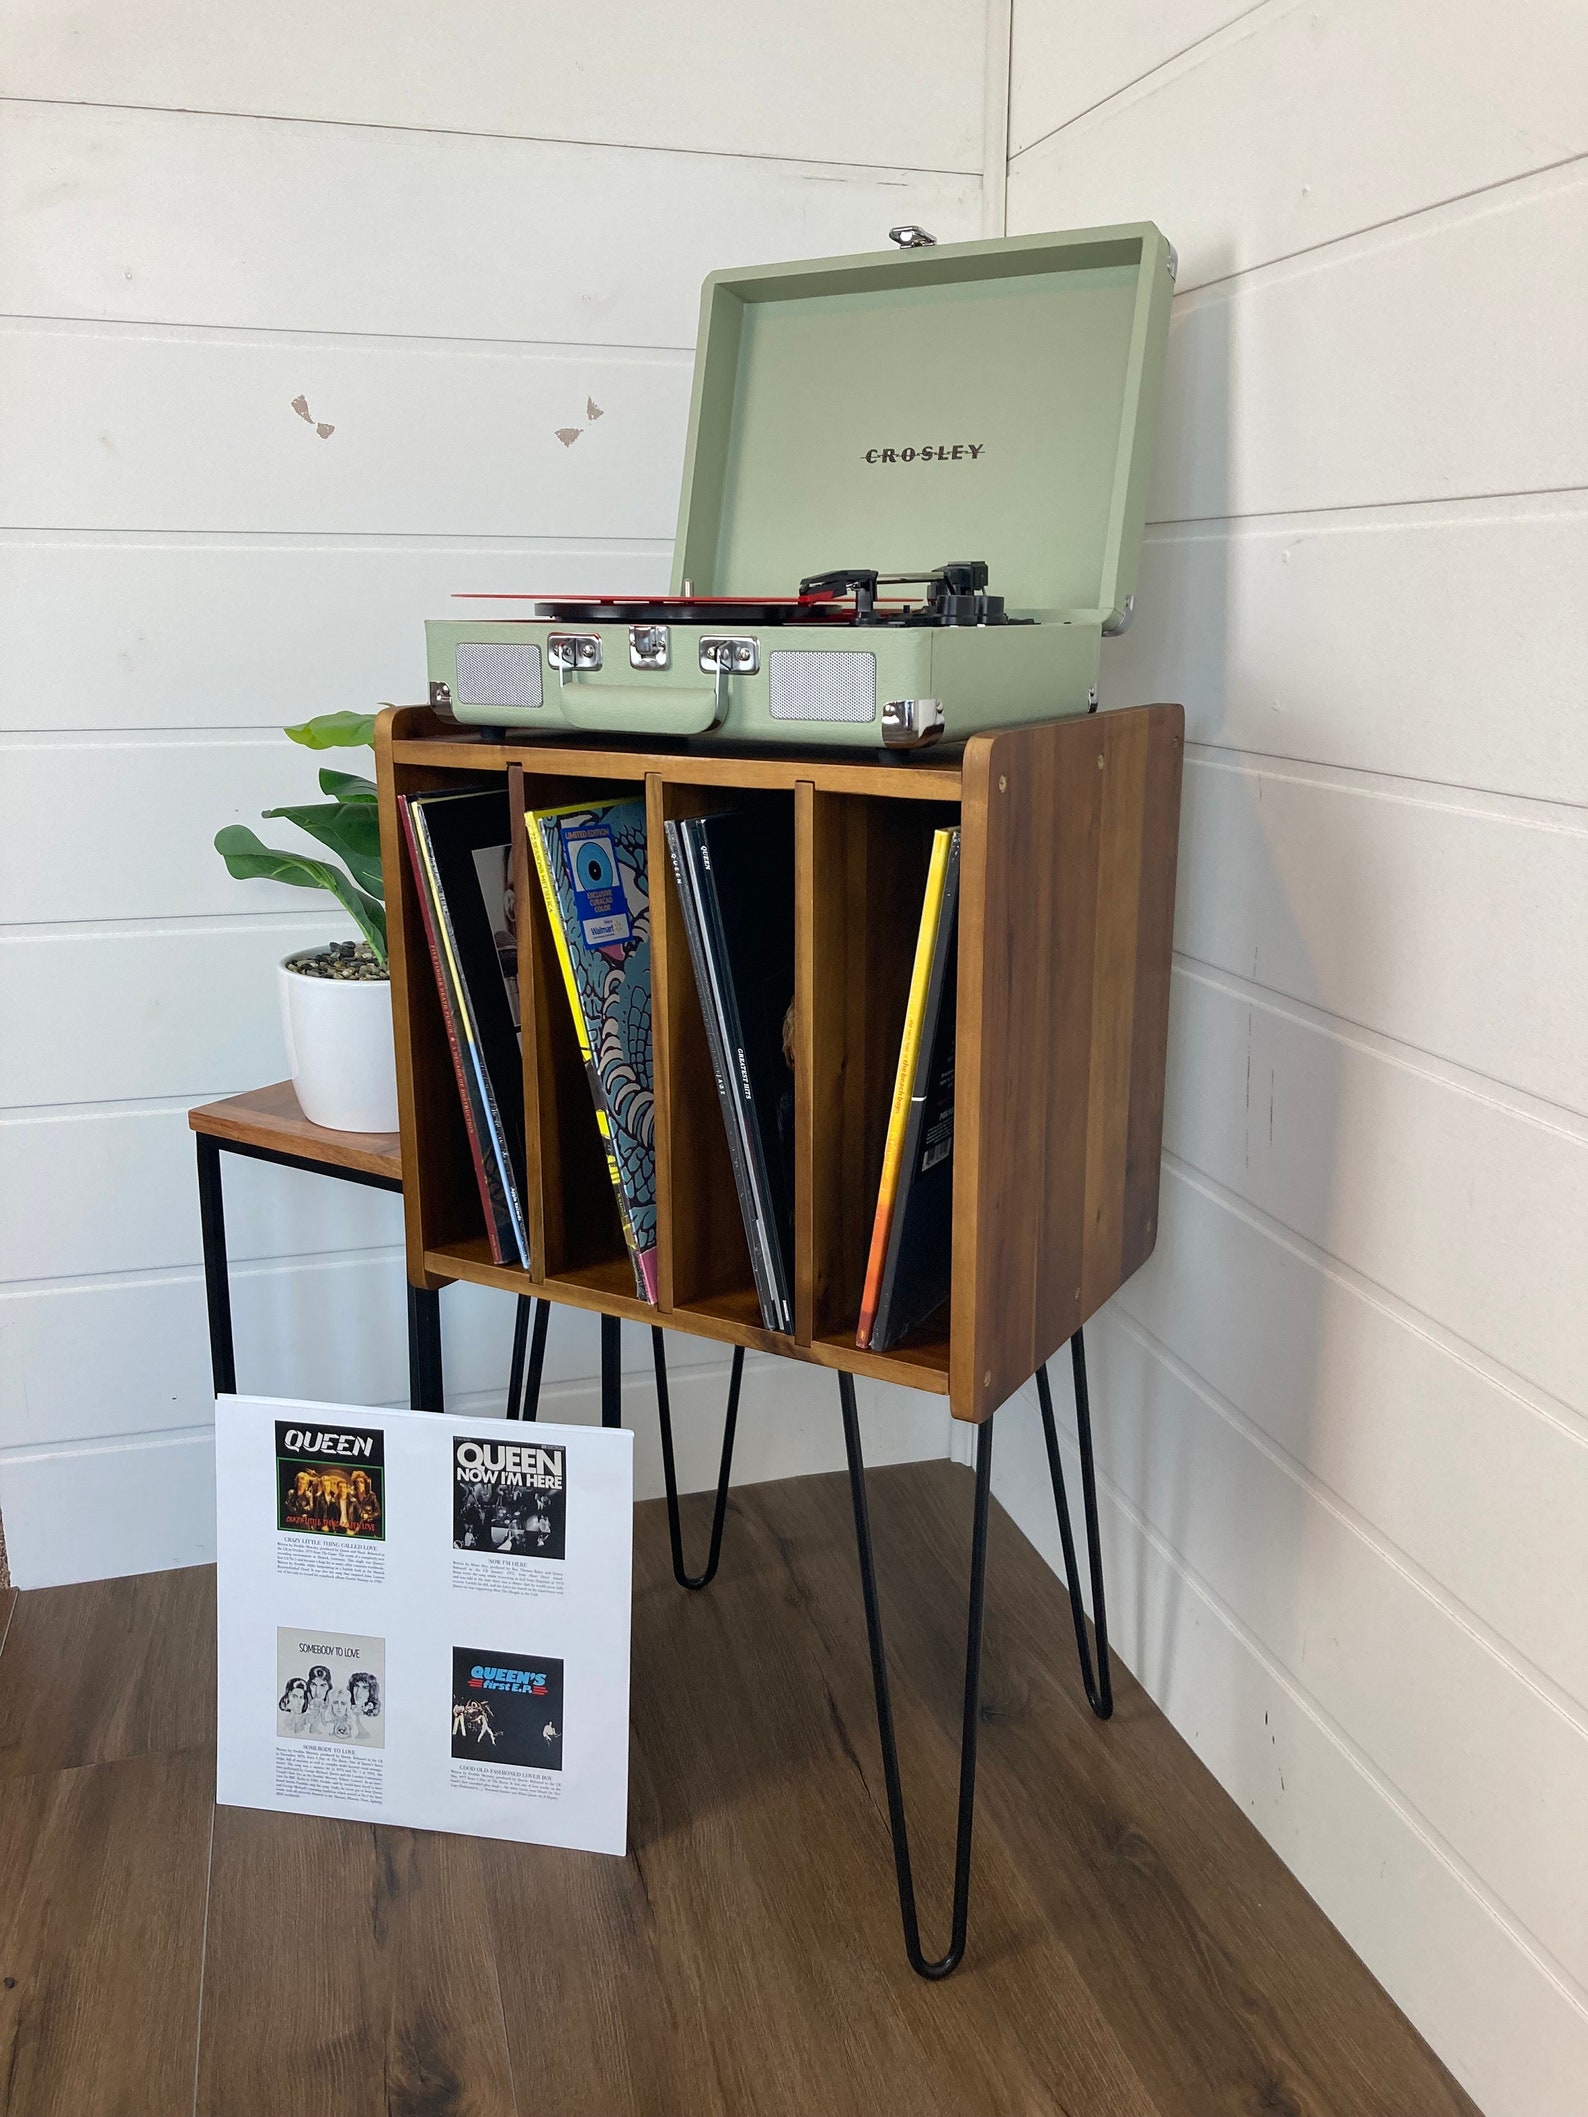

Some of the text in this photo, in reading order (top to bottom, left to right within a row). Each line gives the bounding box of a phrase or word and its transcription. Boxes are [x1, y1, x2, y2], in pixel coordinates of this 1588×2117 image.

[861, 443, 985, 464] CROSLEY
[671, 853, 682, 884] QUEEN
[700, 845, 711, 870] QUEEN
[591, 924, 615, 936] Walmart
[737, 1048, 752, 1099] GREATEST HITS
[284, 1429, 374, 1457] QUEEN
[457, 1442, 562, 1476] QUEEN
[457, 1467, 562, 1490] NOW I'M HERE
[299, 1643, 360, 1658] SOMEBODY TO LOVE
[471, 1666, 547, 1686] QUEEN'S
[483, 1679, 533, 1693] first E.P.
